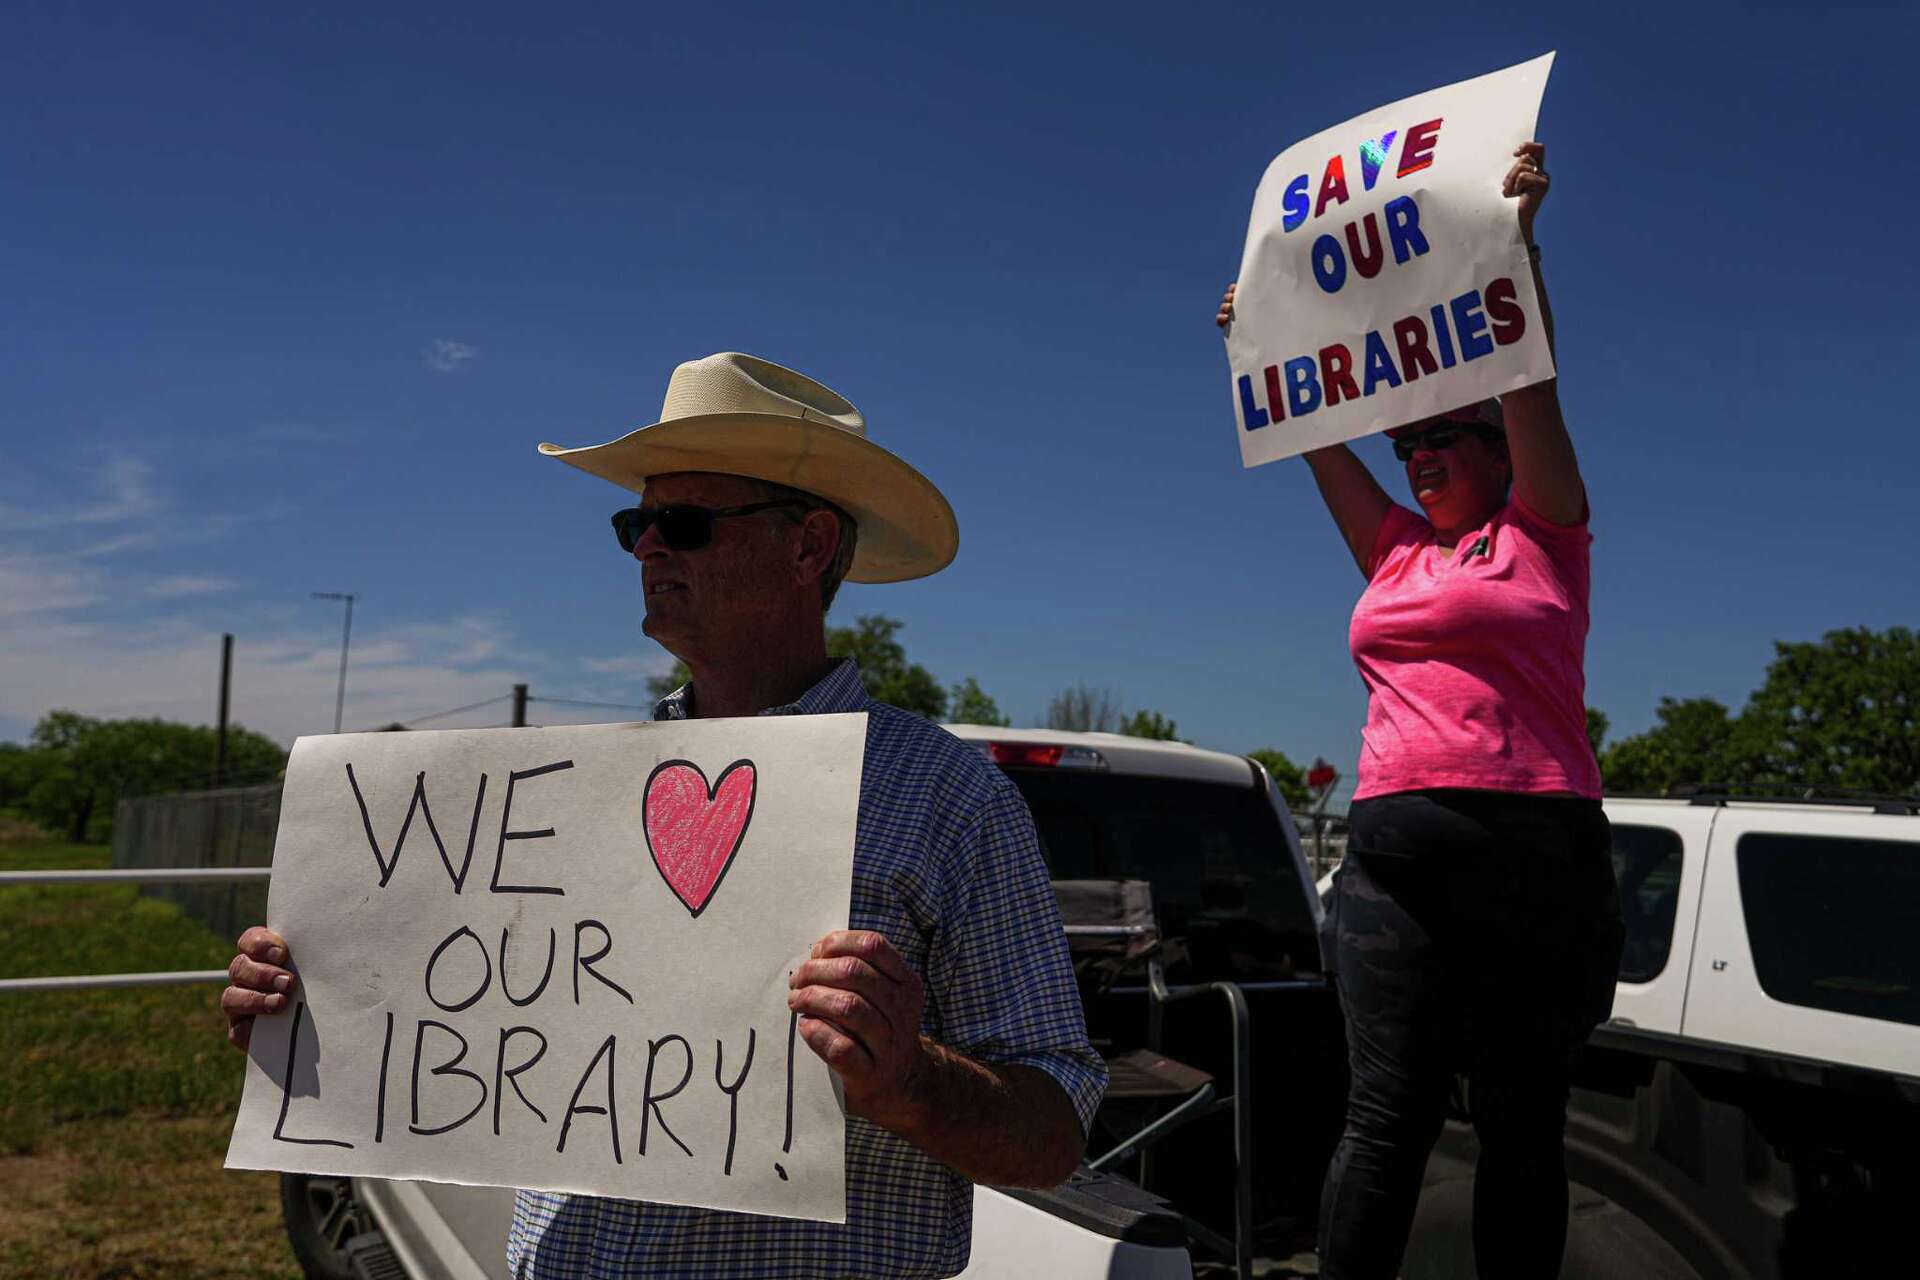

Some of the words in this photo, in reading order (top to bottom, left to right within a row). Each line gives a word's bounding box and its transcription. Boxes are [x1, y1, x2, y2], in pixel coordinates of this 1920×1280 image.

[1282, 118, 1444, 233] SAVE
[1311, 195, 1430, 294] OUR
[1238, 277, 1526, 432] LIBRARIES
[345, 760, 574, 896] WE
[425, 919, 634, 1012] OUR
[273, 1001, 798, 1181] LIBRARY!
